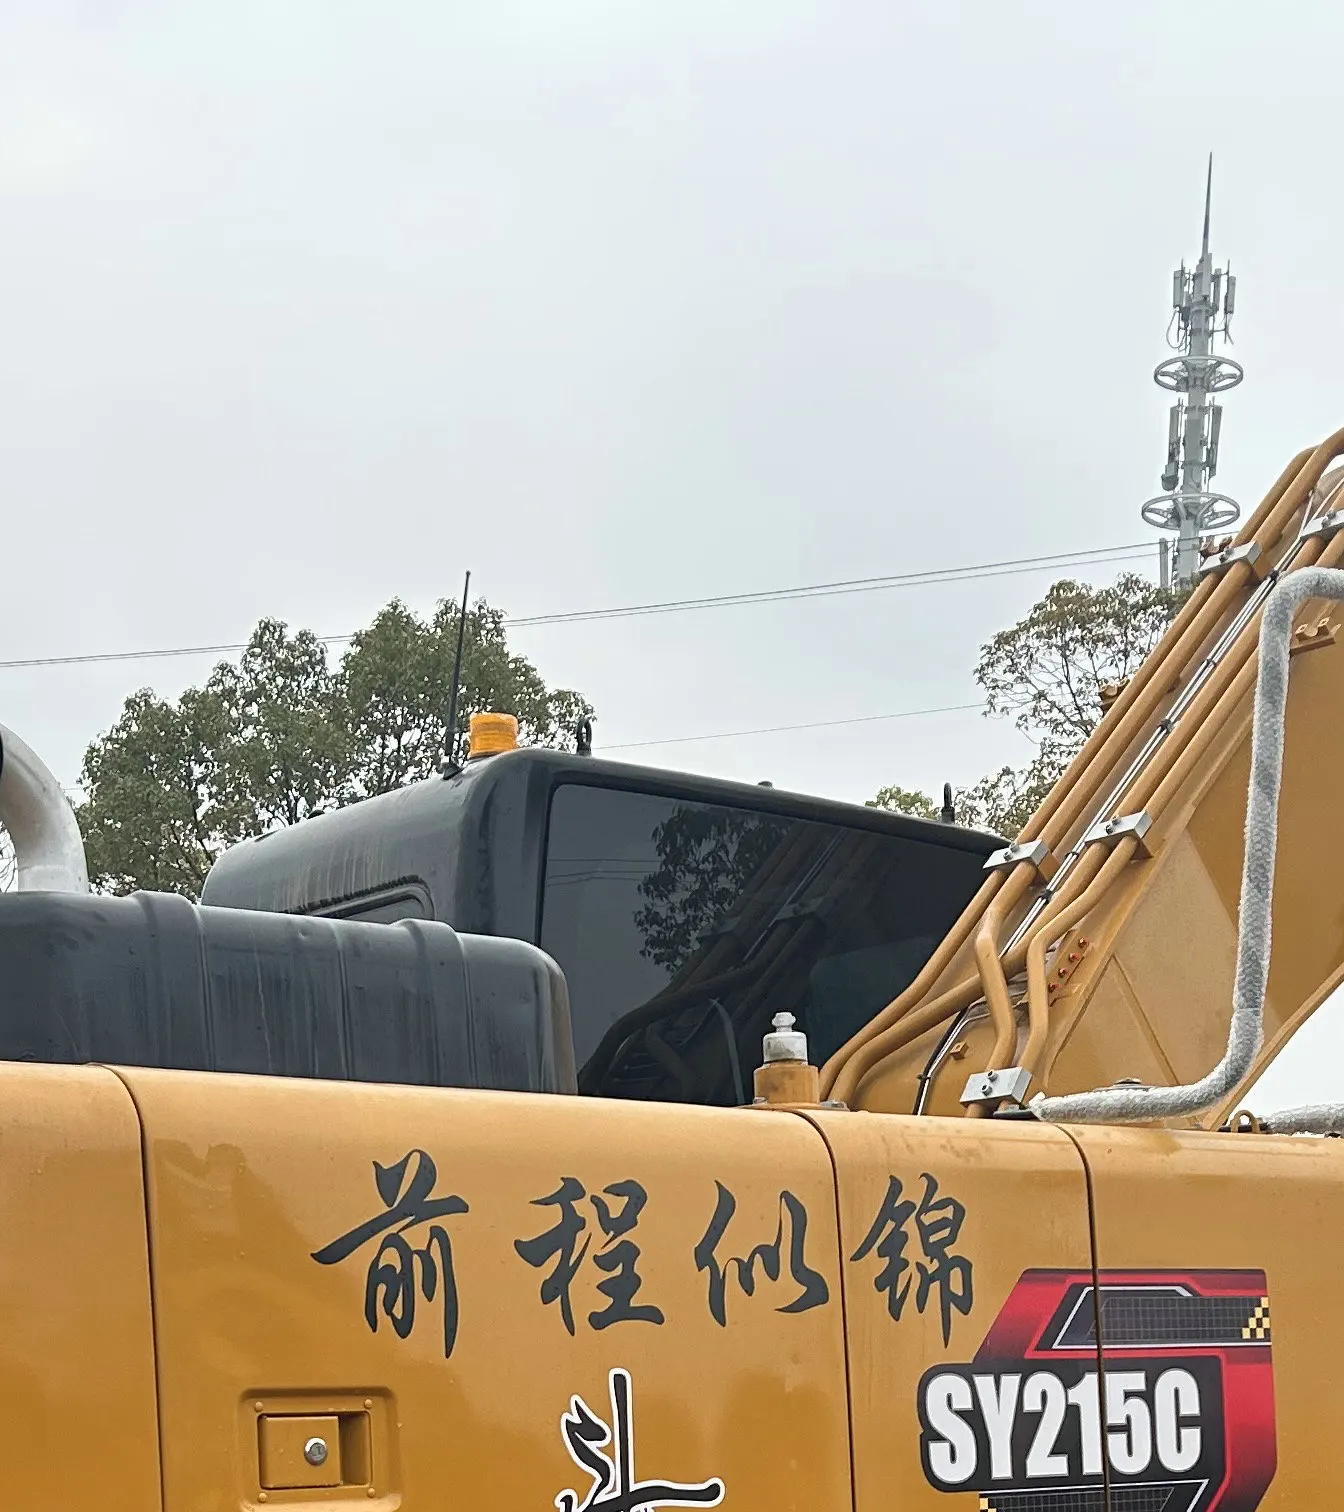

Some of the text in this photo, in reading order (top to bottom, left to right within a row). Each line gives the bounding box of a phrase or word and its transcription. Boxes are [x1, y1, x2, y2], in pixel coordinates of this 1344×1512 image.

[309, 1148, 975, 1360] 前程似锦
[924, 1366, 1203, 1485] SY215C
